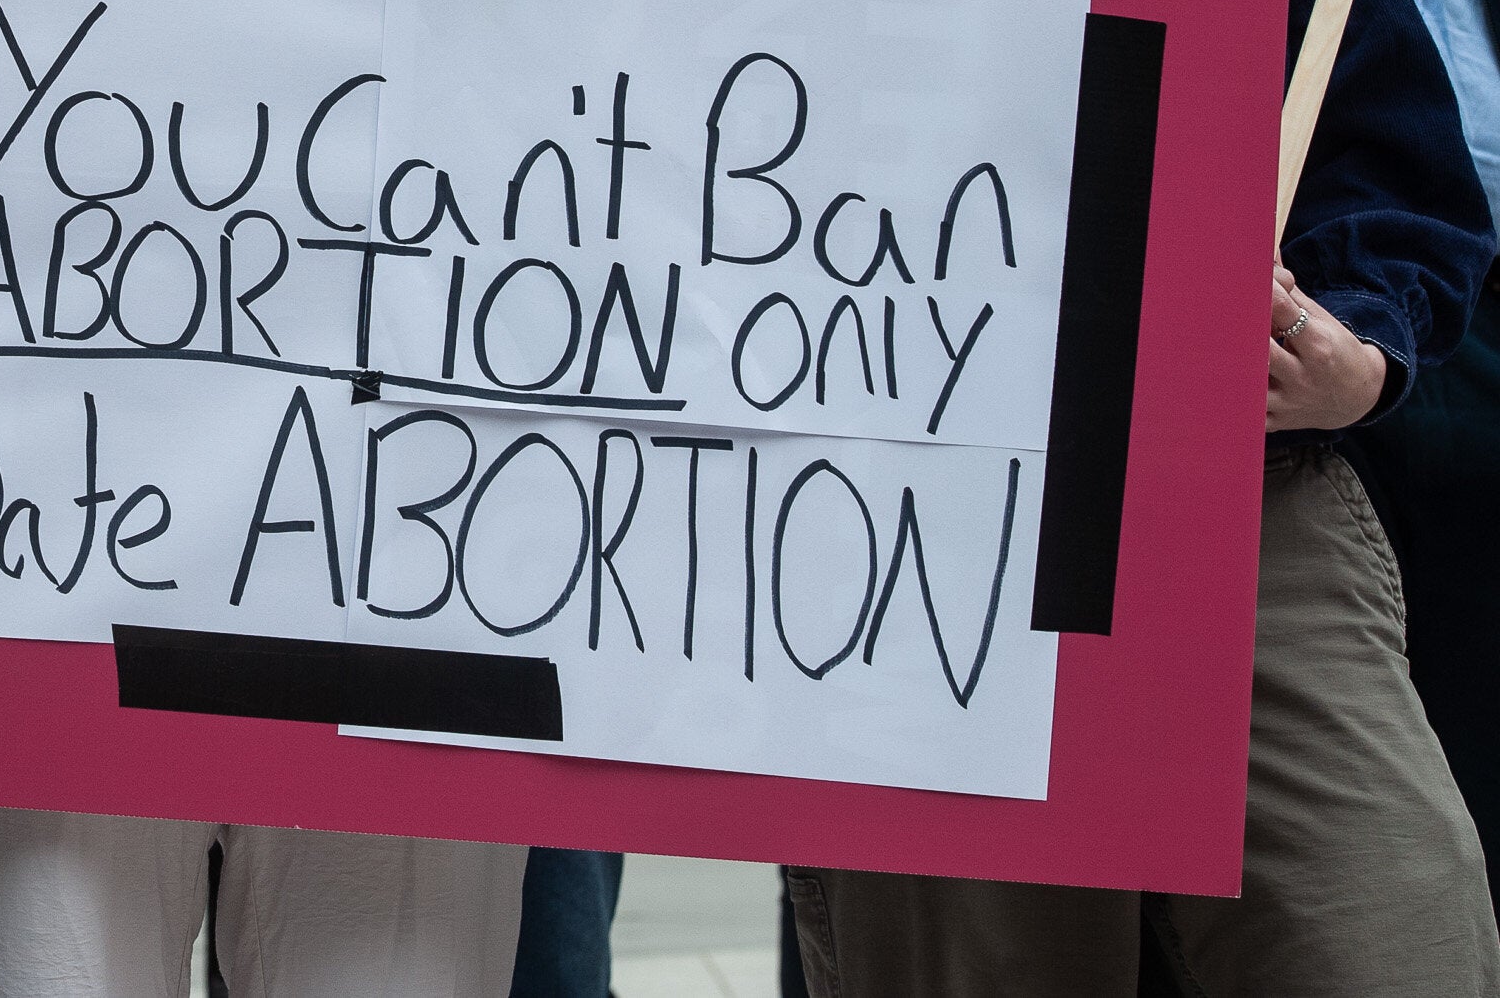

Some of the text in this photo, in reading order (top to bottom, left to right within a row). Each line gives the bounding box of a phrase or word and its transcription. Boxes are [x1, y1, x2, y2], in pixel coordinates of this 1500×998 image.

[295, 72, 651, 248] Can't
[701, 52, 1018, 288] Ban
[229, 385, 1022, 710] ABORTION
